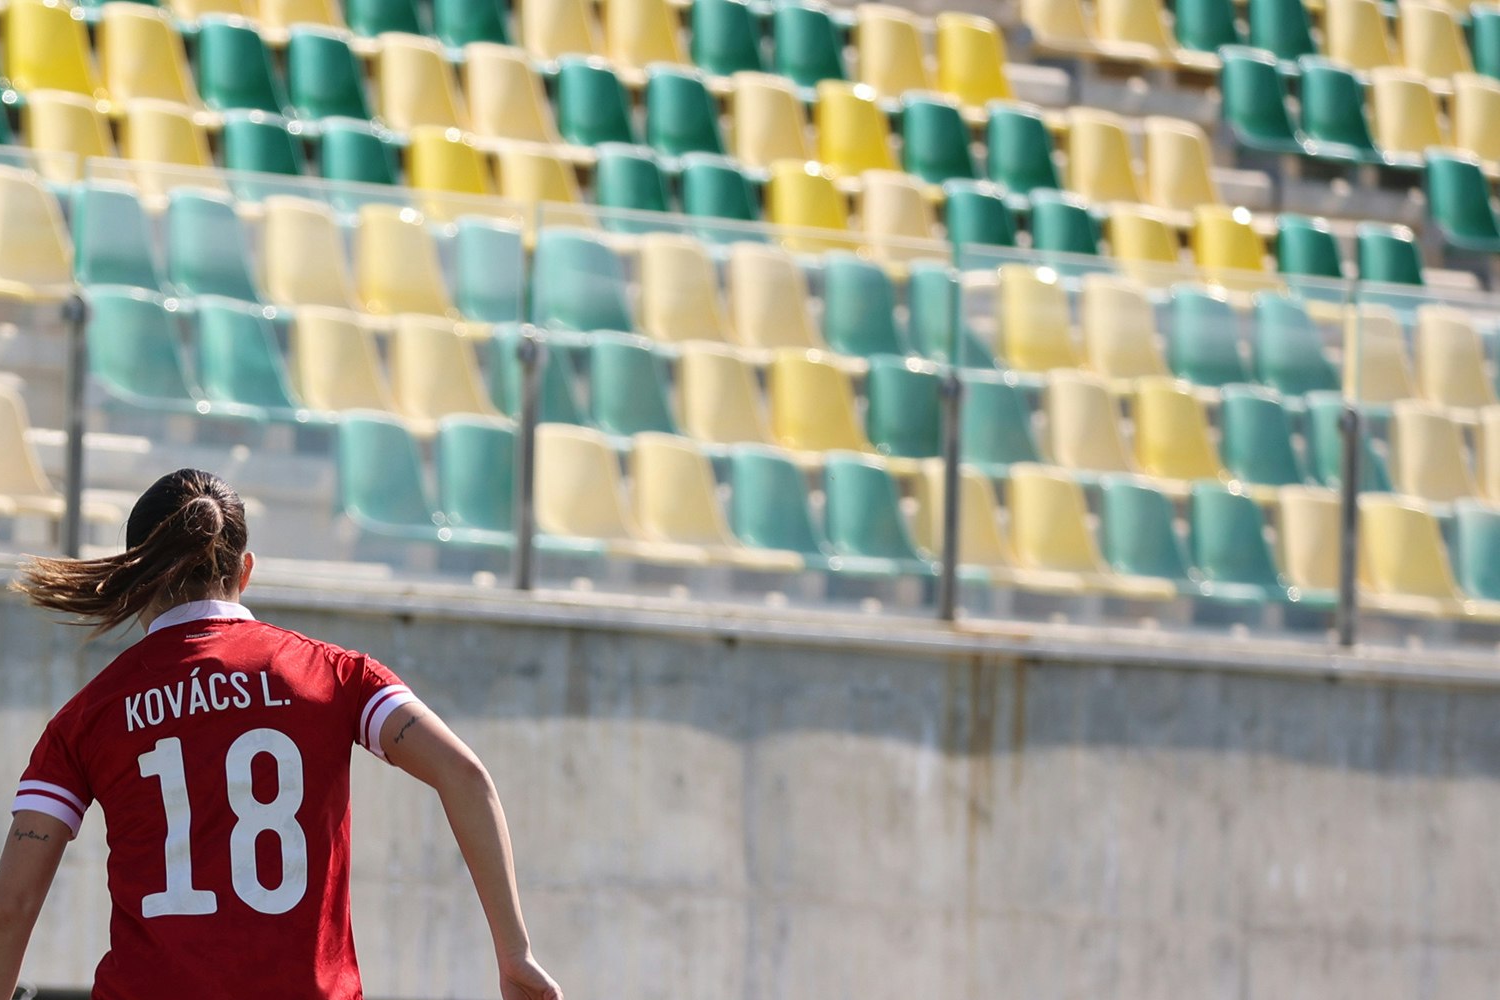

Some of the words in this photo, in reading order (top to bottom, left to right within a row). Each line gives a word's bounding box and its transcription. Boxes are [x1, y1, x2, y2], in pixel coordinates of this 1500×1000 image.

[124, 667, 251, 732] KOVÁCS
[259, 670, 291, 707] L.
[137, 727, 308, 918] 18
